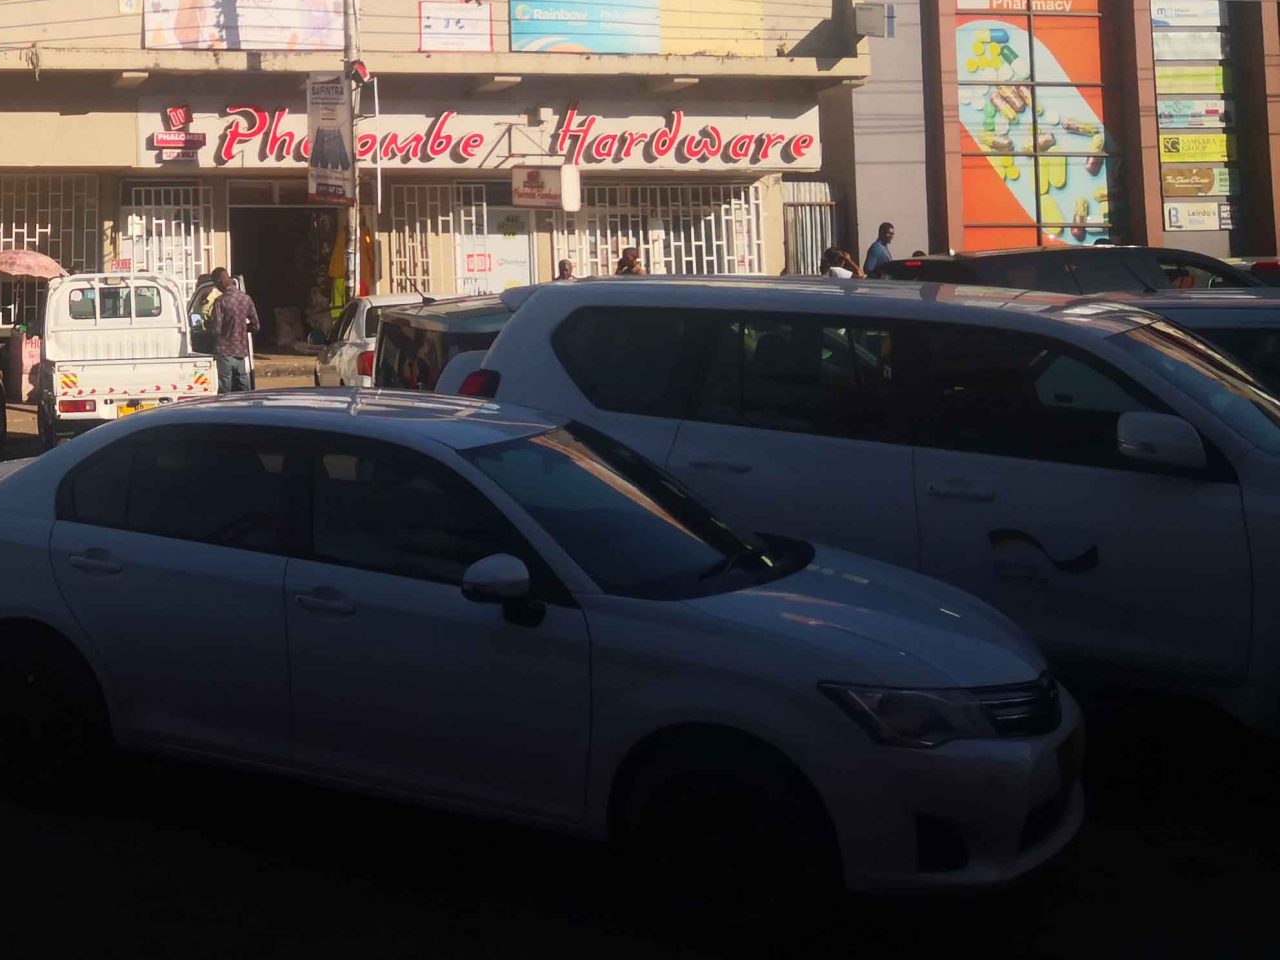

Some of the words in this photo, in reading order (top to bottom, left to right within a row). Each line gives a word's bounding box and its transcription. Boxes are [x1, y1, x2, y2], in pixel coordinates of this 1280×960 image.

[533, 8, 587, 20] Rainbow
[221, 106, 485, 162] Phombe
[558, 100, 815, 165] Hardware
